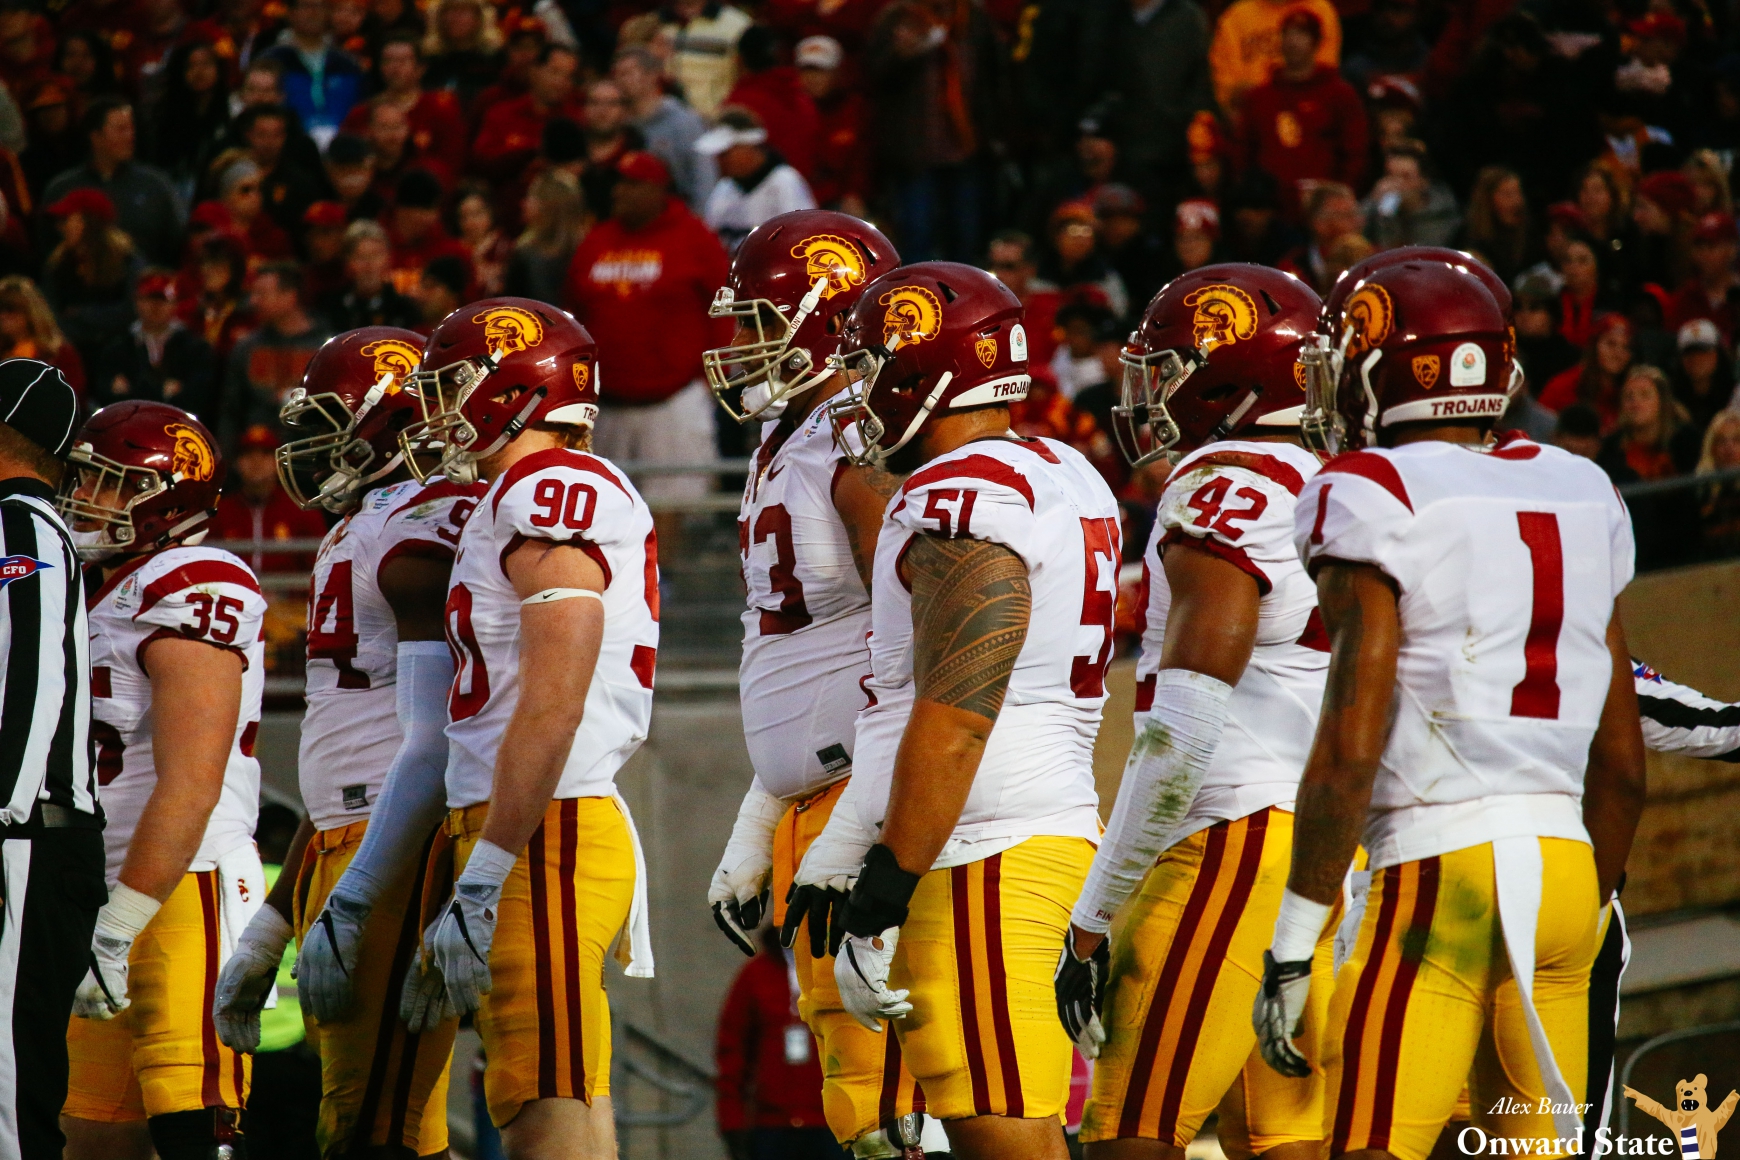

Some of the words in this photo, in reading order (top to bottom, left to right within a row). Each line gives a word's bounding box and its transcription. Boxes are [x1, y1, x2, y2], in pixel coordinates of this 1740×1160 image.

[982, 351, 993, 363] 12
[1431, 398, 1504, 417] TROJANS
[436, 499, 480, 545] 9
[529, 478, 598, 531] 90
[922, 488, 979, 539] 51
[1187, 475, 1269, 542] 42
[1310, 483, 1333, 545] 1
[3, 565, 27, 575] CFO
[180, 592, 245, 645] 35
[1070, 516, 1122, 699] 5
[1509, 510, 1565, 720] 1
